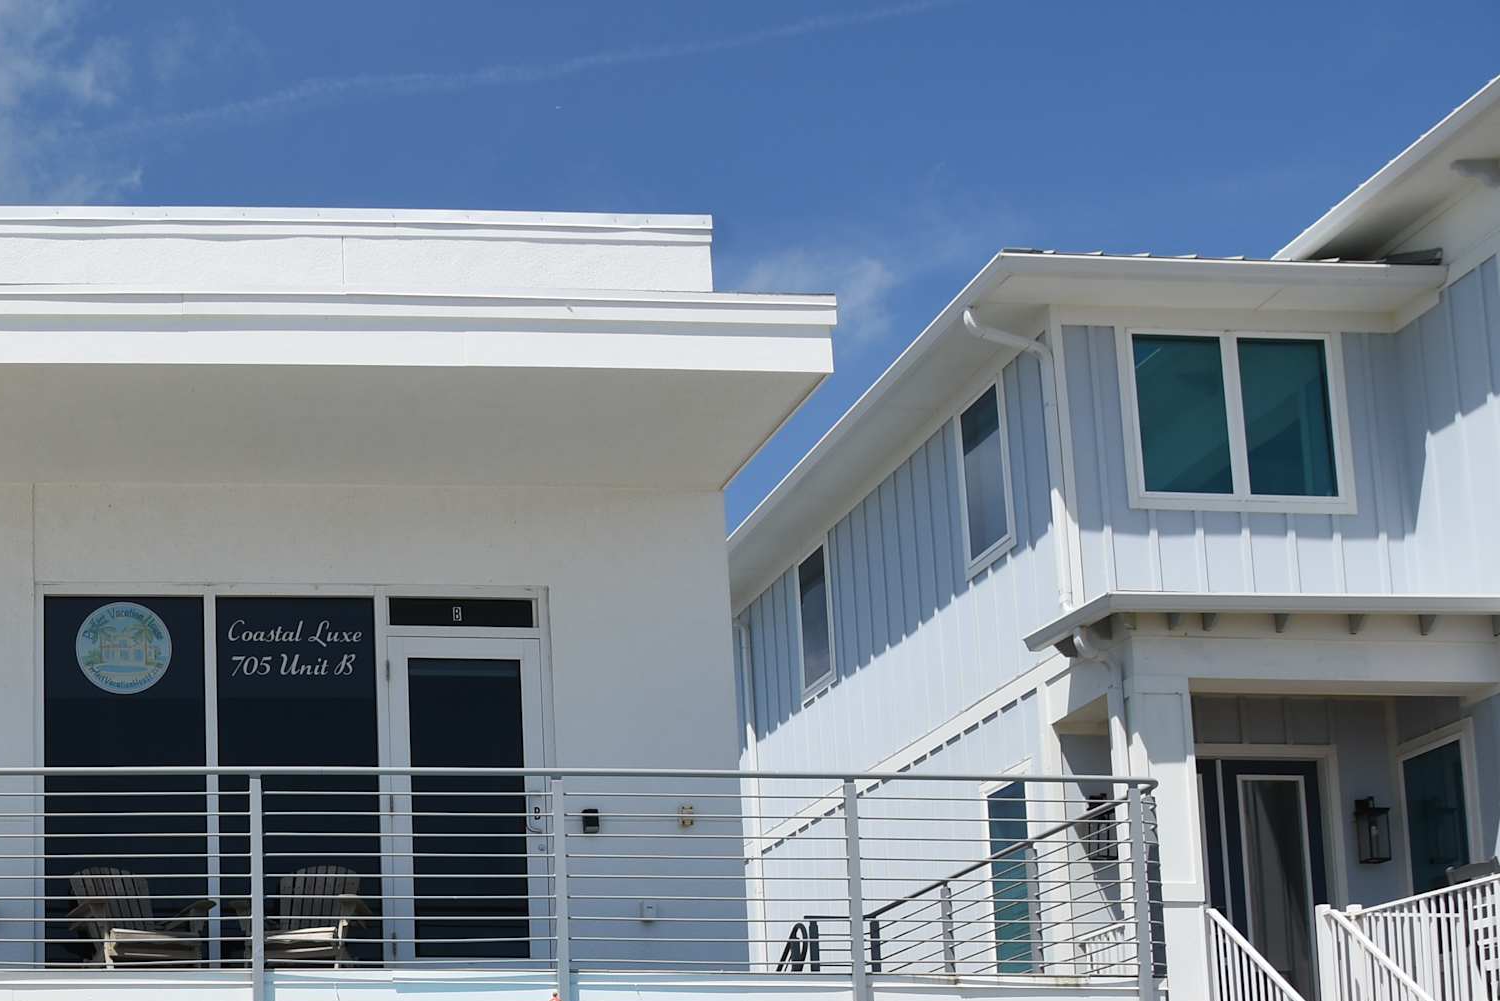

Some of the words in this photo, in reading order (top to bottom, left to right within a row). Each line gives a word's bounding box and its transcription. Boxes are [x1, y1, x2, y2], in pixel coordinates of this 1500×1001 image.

[228, 619, 303, 642] Coastal
[307, 619, 362, 647] Luxe
[231, 656, 272, 676] 705
[279, 653, 329, 676] Unit
[333, 653, 356, 676] B
